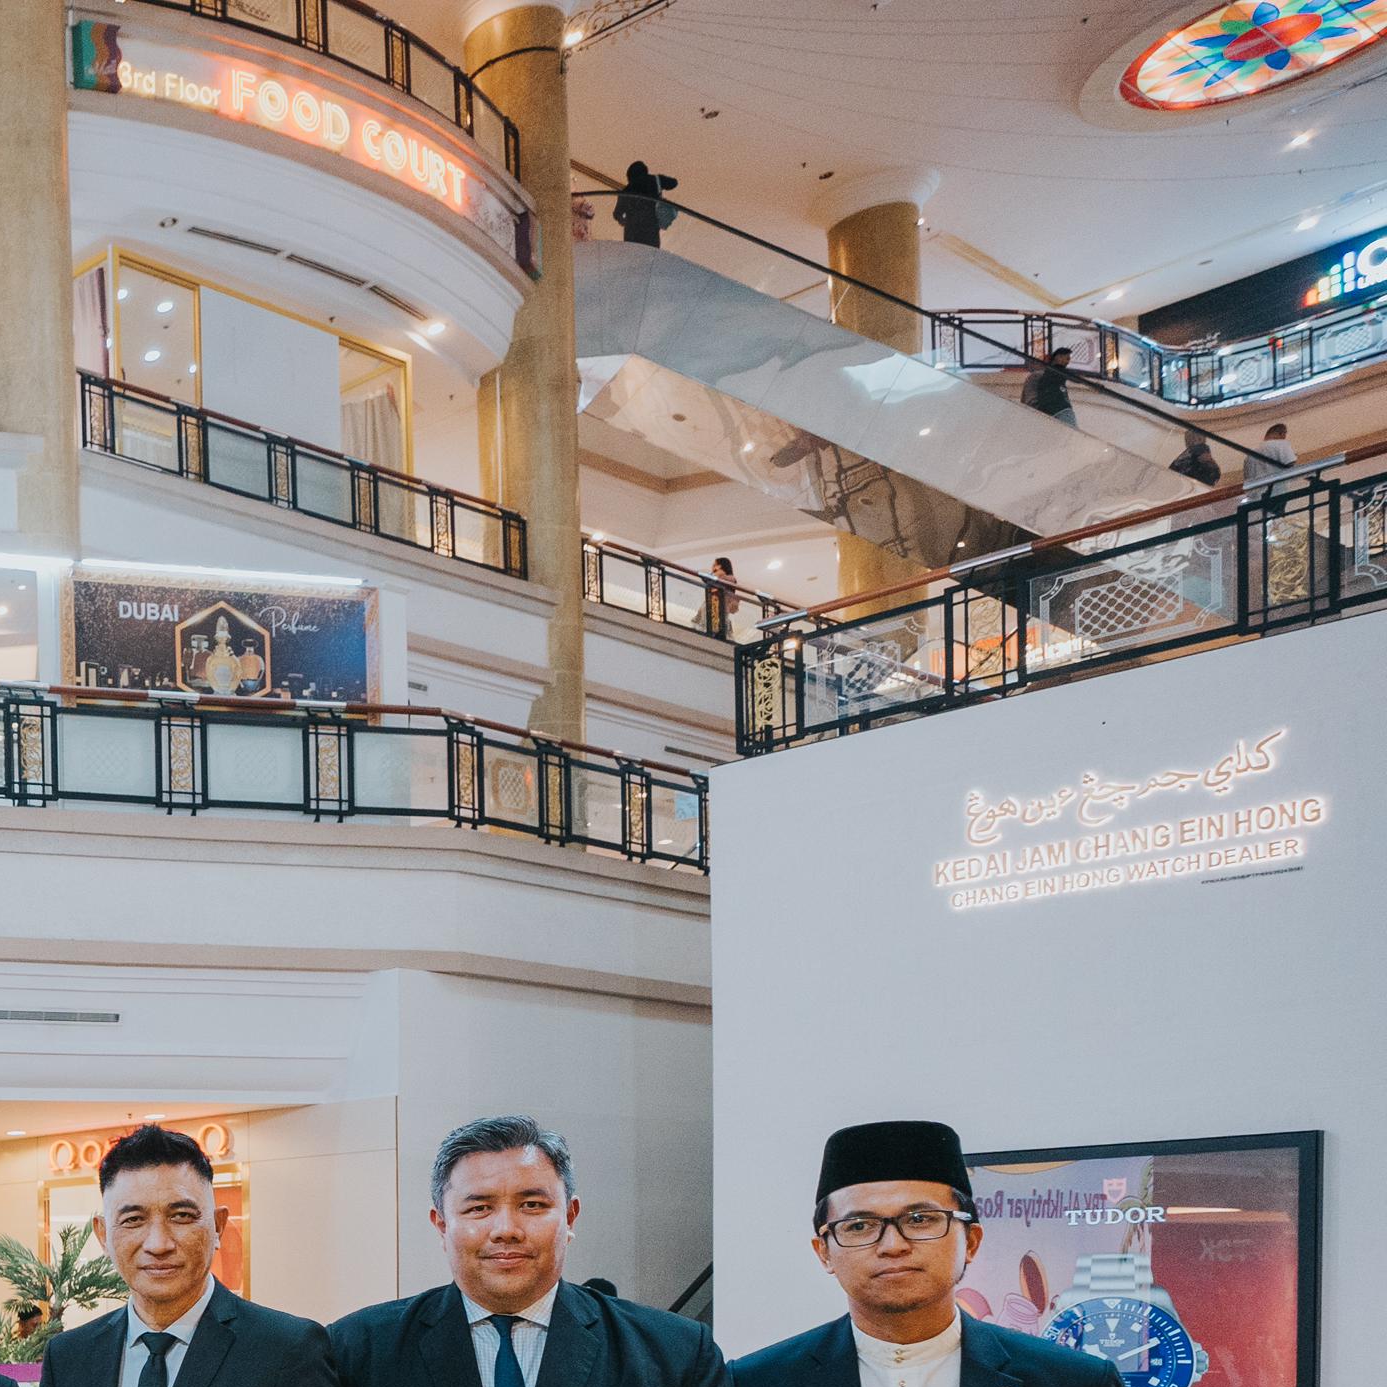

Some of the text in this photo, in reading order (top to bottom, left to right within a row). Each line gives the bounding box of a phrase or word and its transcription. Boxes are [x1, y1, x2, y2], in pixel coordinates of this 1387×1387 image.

[118, 61, 466, 206] 3rd Floor FOOD COURT
[117, 600, 321, 638] DUBAI Perfume
[934, 798, 1323, 887] KEDAI JAM CHANG EIN HONG
[951, 884, 1019, 910] CHANG
[1024, 876, 1056, 899] EIN
[1062, 868, 1121, 892] HONG
[1128, 854, 1201, 881] WATCH
[1207, 839, 1299, 868] DEALER
[1064, 1205, 1166, 1227] TUDOR
